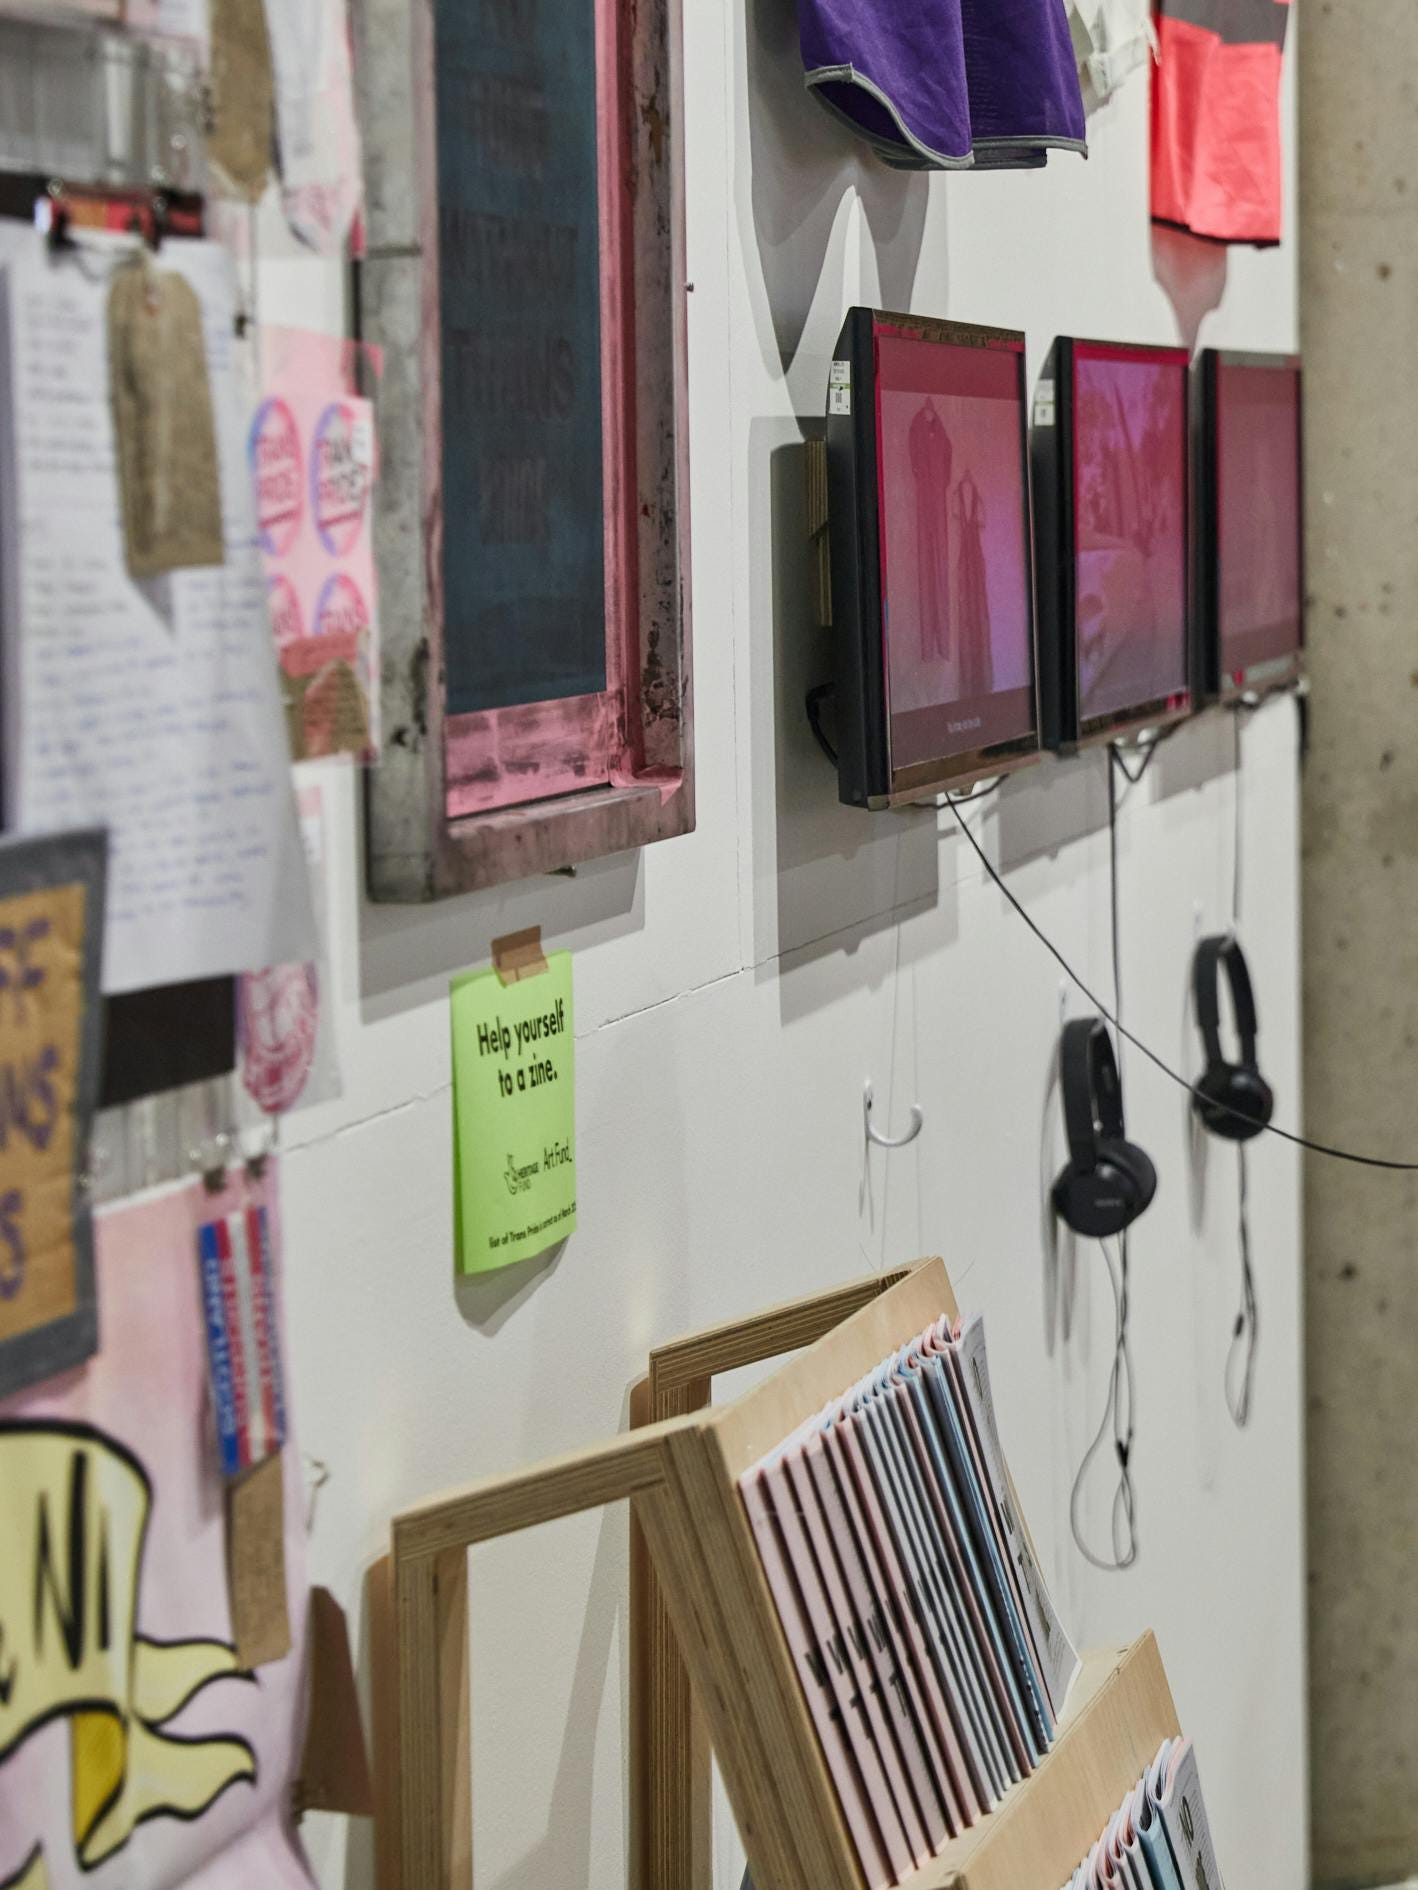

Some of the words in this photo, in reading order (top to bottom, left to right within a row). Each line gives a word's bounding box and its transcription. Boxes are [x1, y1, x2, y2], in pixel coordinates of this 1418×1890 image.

[476, 1014, 512, 1061] Help
[513, 997, 565, 1057] yourself
[498, 1068, 513, 1098] to
[516, 1068, 527, 1092] a
[528, 1051, 558, 1088] zine.
